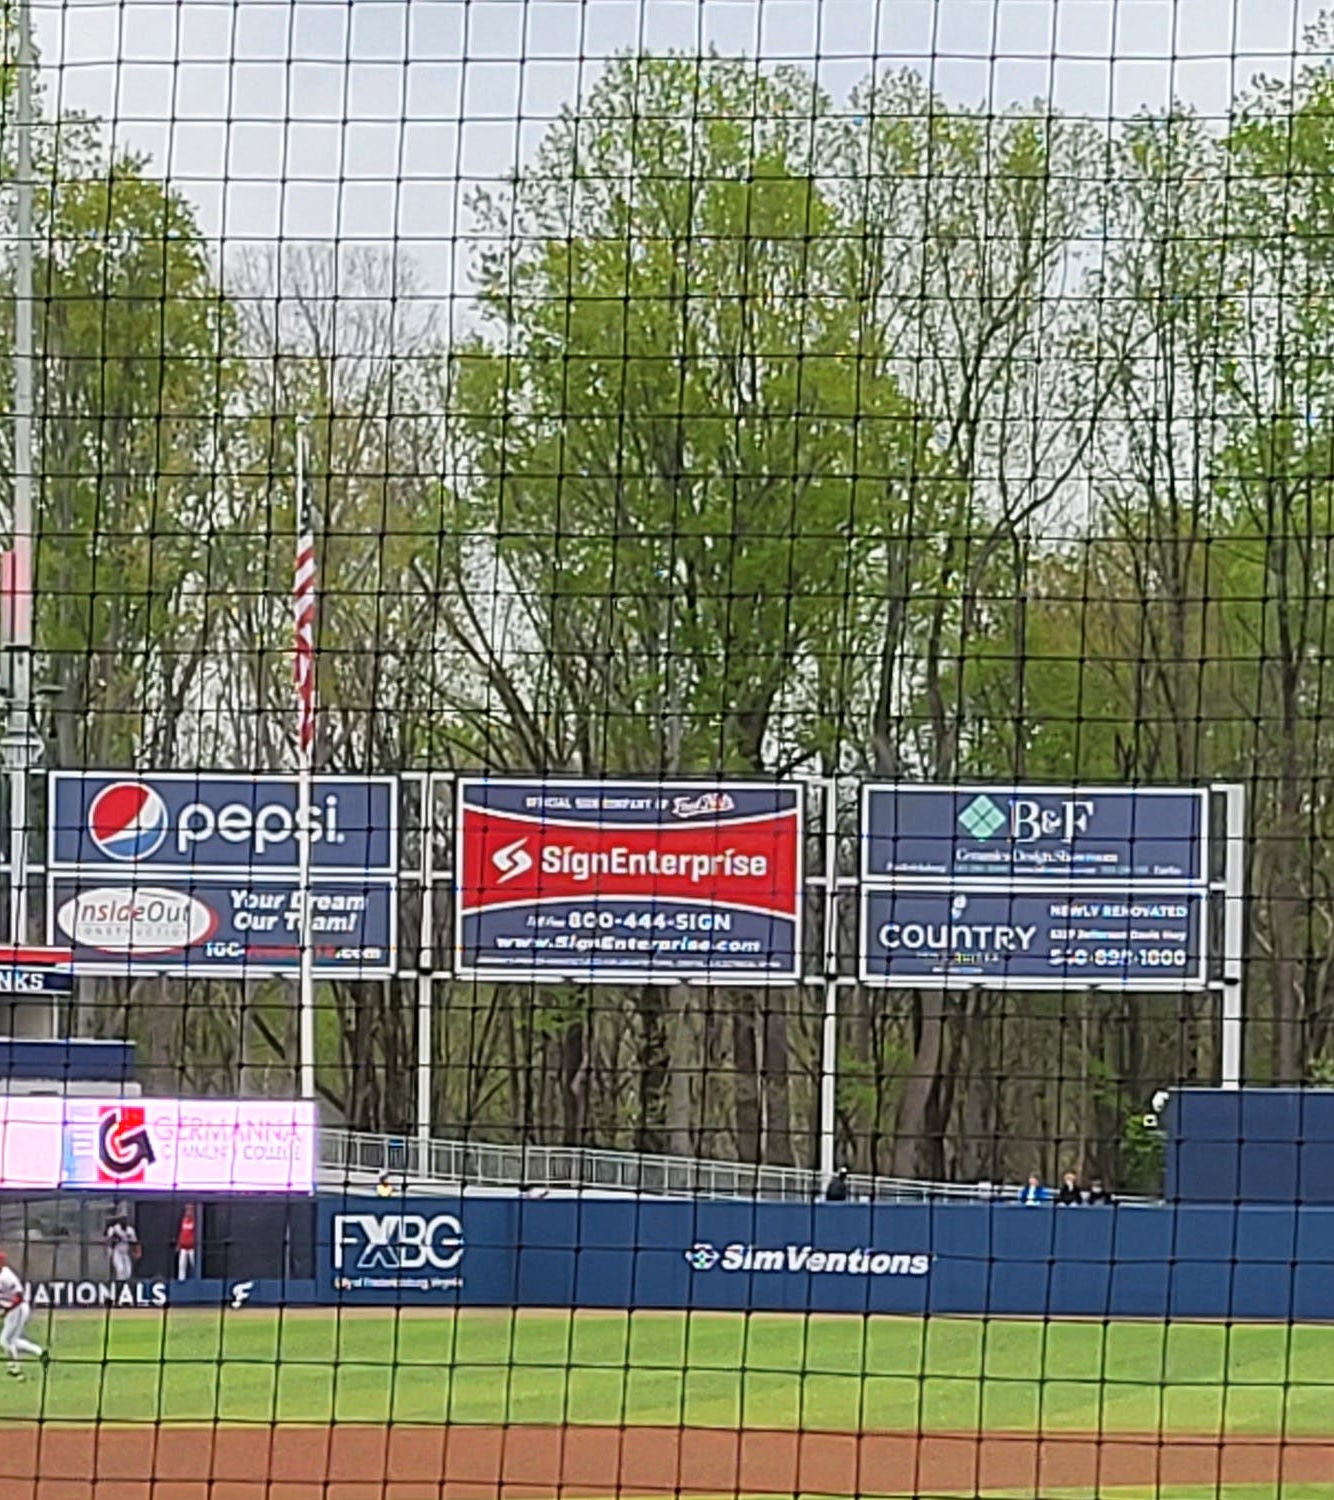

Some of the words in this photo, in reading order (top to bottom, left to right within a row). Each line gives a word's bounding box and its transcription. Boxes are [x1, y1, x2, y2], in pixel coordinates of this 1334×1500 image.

[1007, 800, 1094, 844] B&F
[541, 845, 767, 883] SignEnterprise
[230, 890, 285, 909] Your
[233, 911, 279, 931] Our
[284, 912, 358, 932] Tam!
[720, 1242, 929, 1275] SimVentions
